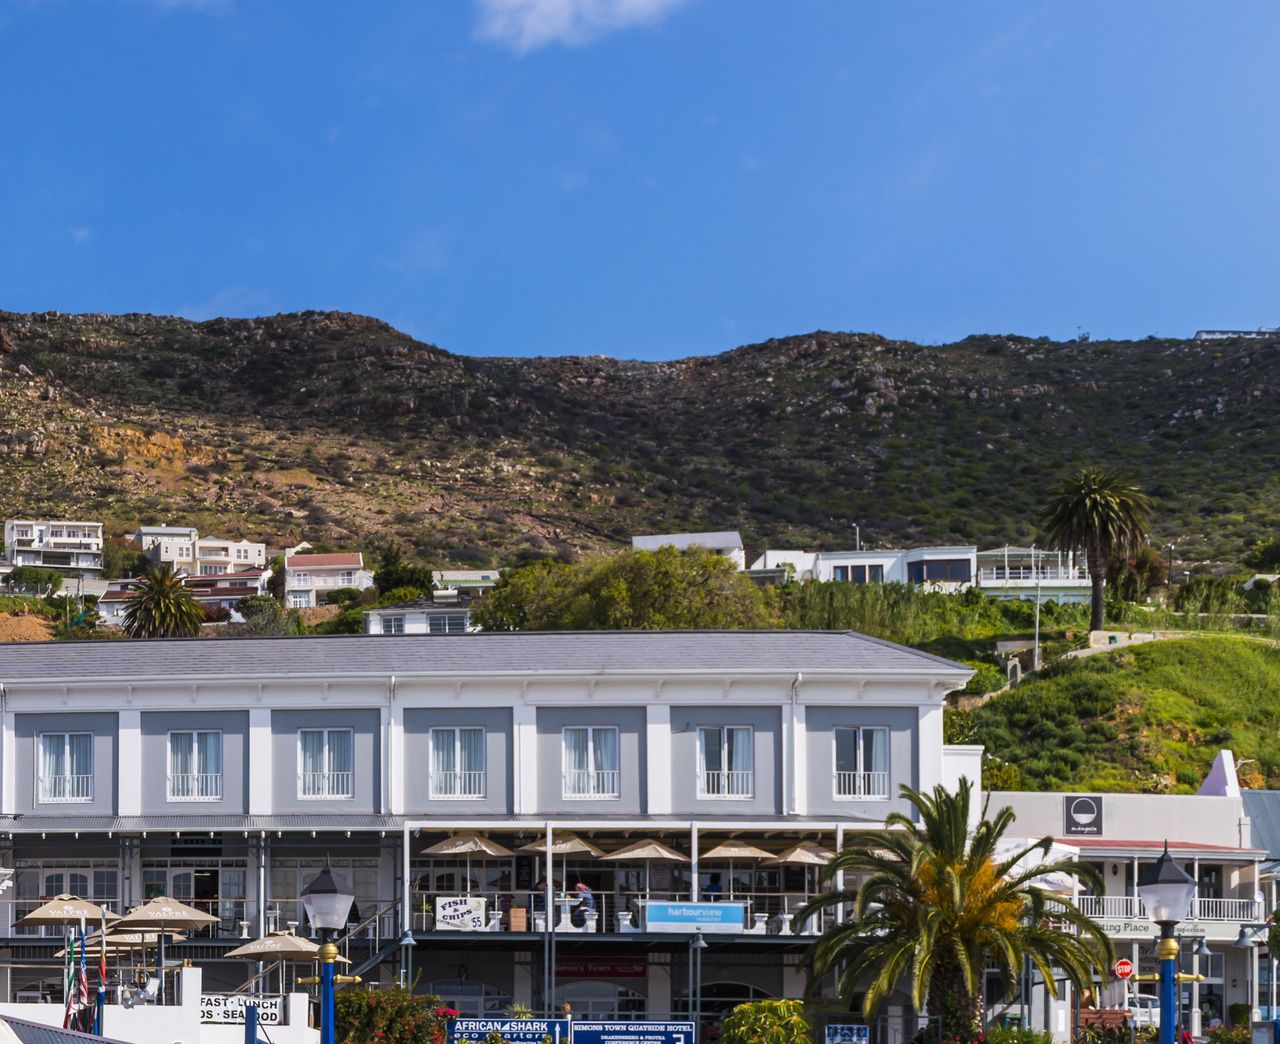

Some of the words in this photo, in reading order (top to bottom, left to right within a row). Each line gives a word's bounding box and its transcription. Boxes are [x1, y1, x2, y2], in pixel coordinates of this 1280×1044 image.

[441, 899, 468, 911] FISH
[442, 908, 472, 921] CHIPS
[668, 906, 722, 916] harbourview
[471, 916, 482, 928] 55
[1123, 922, 1150, 932] Place
[1117, 965, 1132, 974] STOP
[222, 1010, 278, 1022] SEAOD
[454, 1021, 501, 1031] AFRICAN
[511, 1021, 548, 1031] SHARK
[486, 1032, 548, 1040] arters
